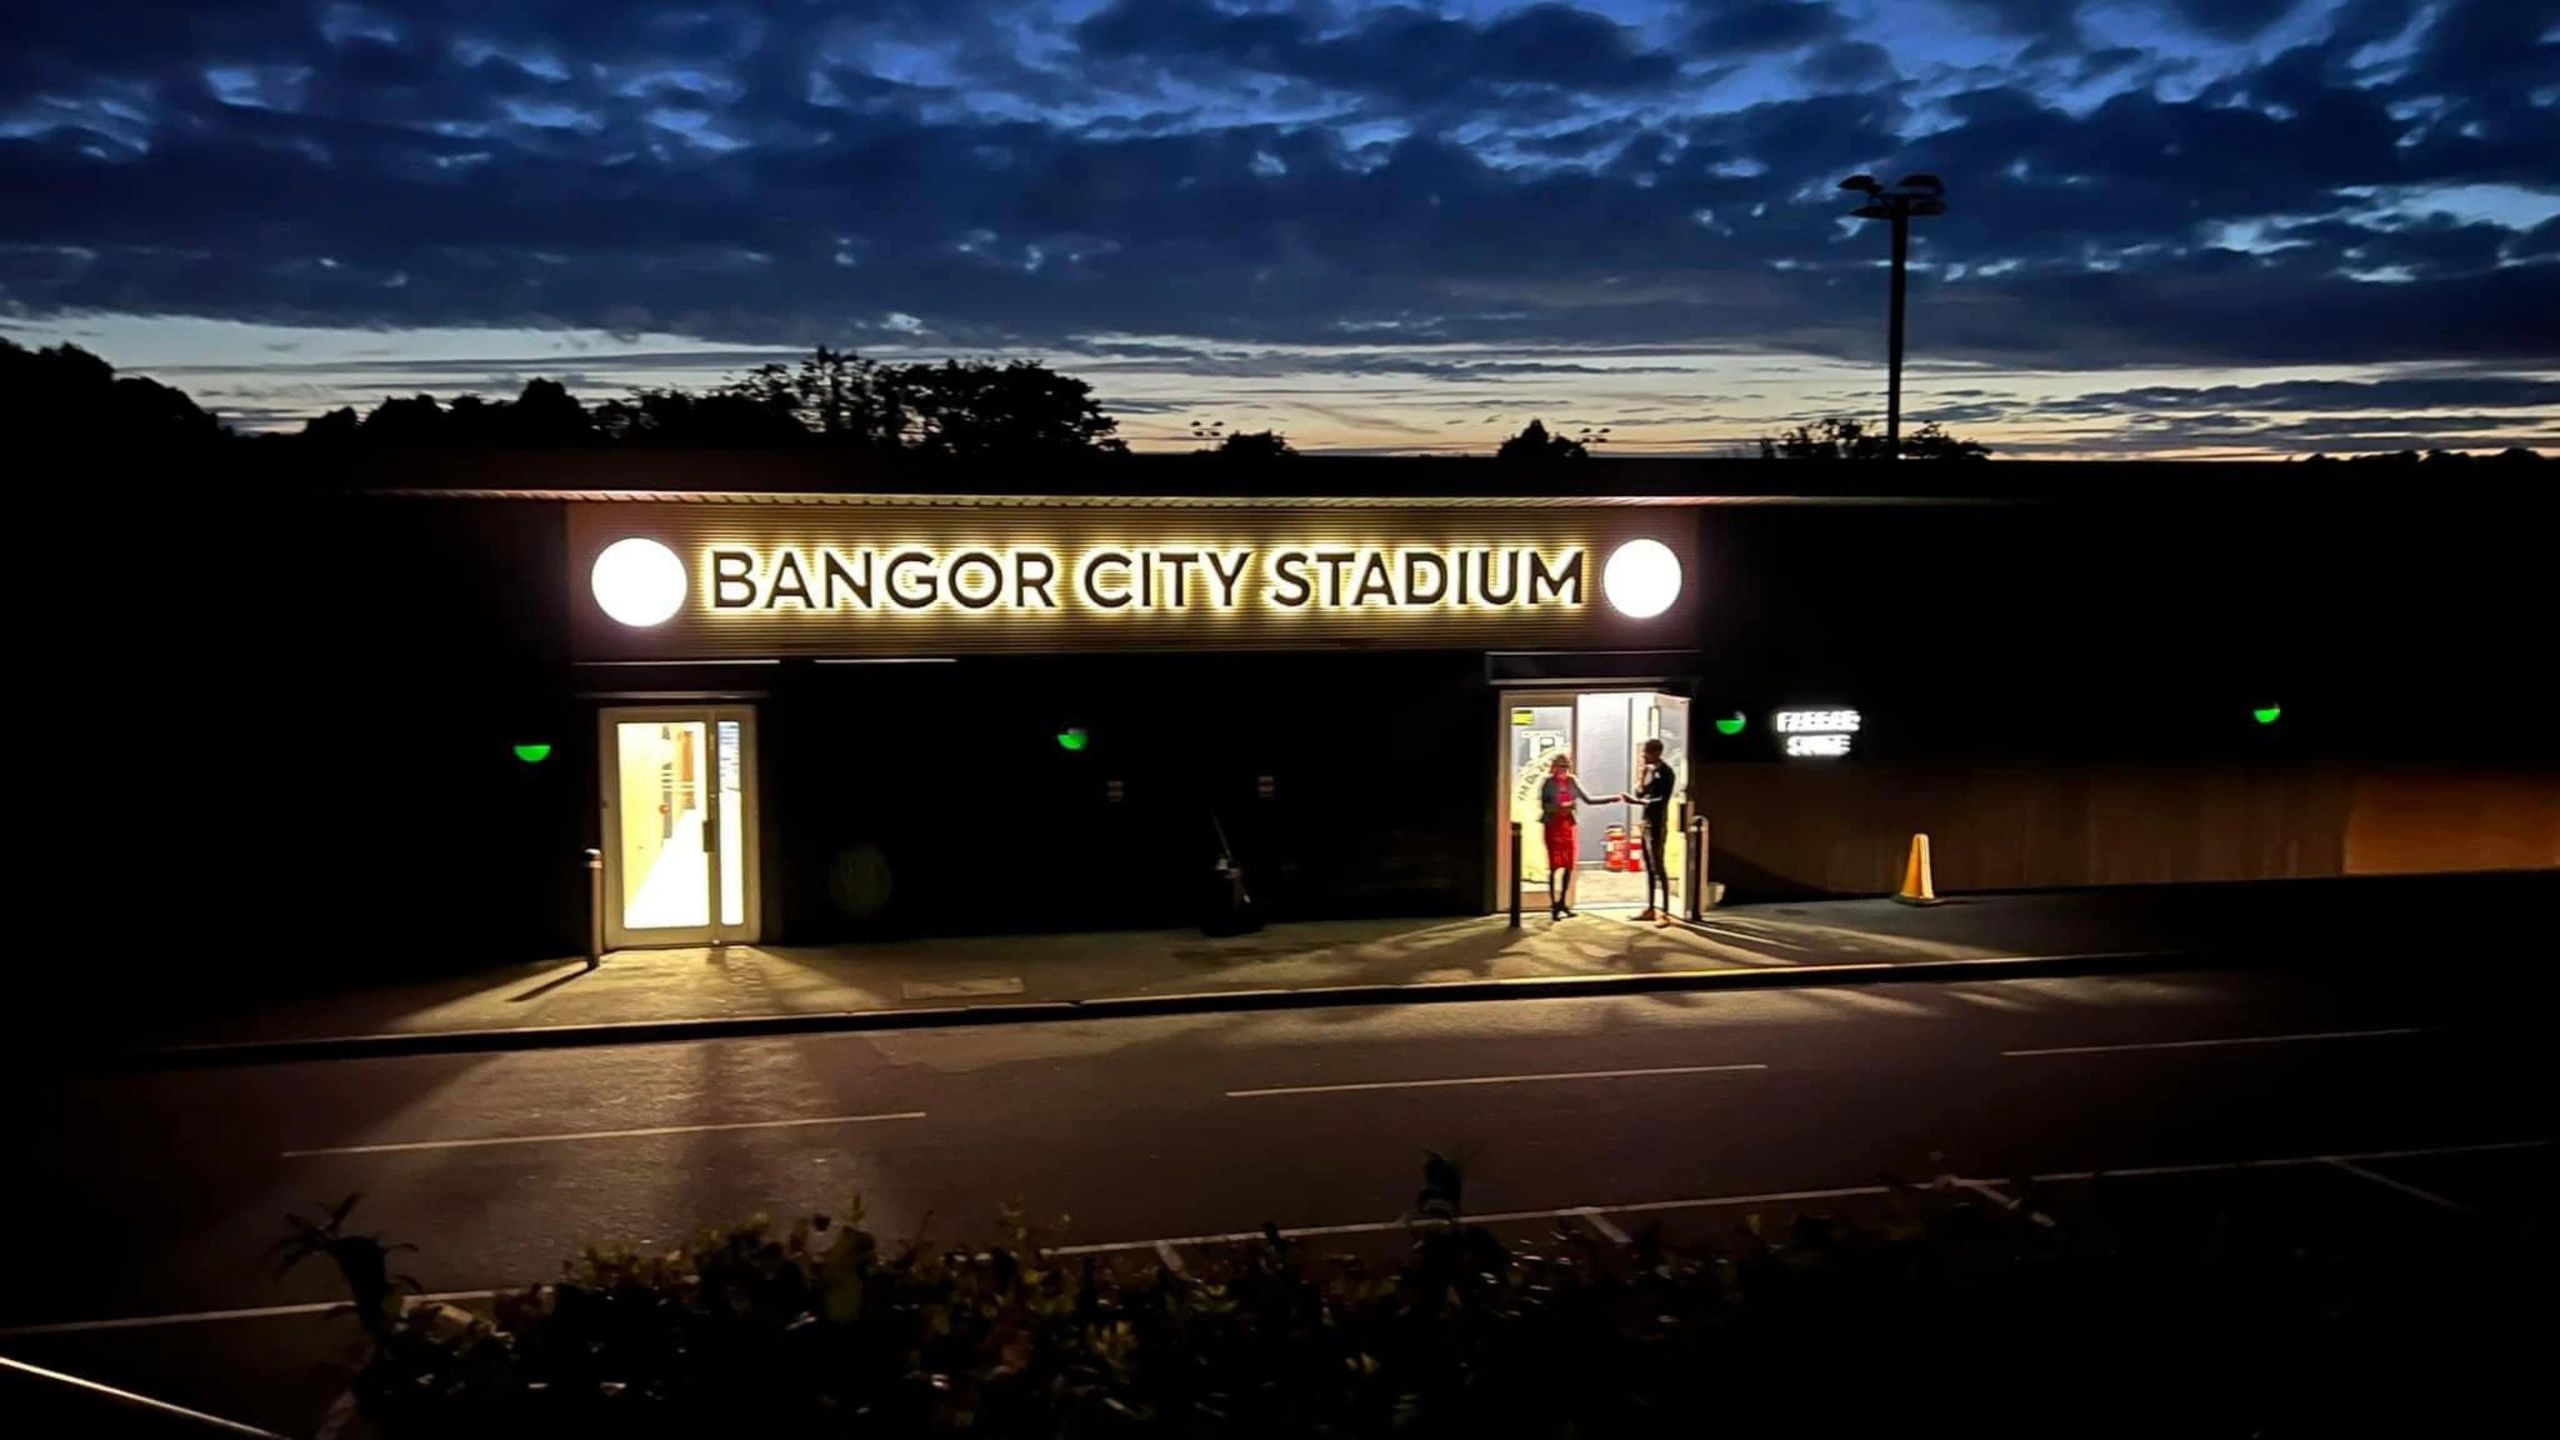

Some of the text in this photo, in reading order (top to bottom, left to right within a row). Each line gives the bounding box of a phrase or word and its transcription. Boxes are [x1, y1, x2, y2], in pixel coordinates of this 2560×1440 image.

[712, 550, 1584, 608] BANGOR CITY STADIUM
